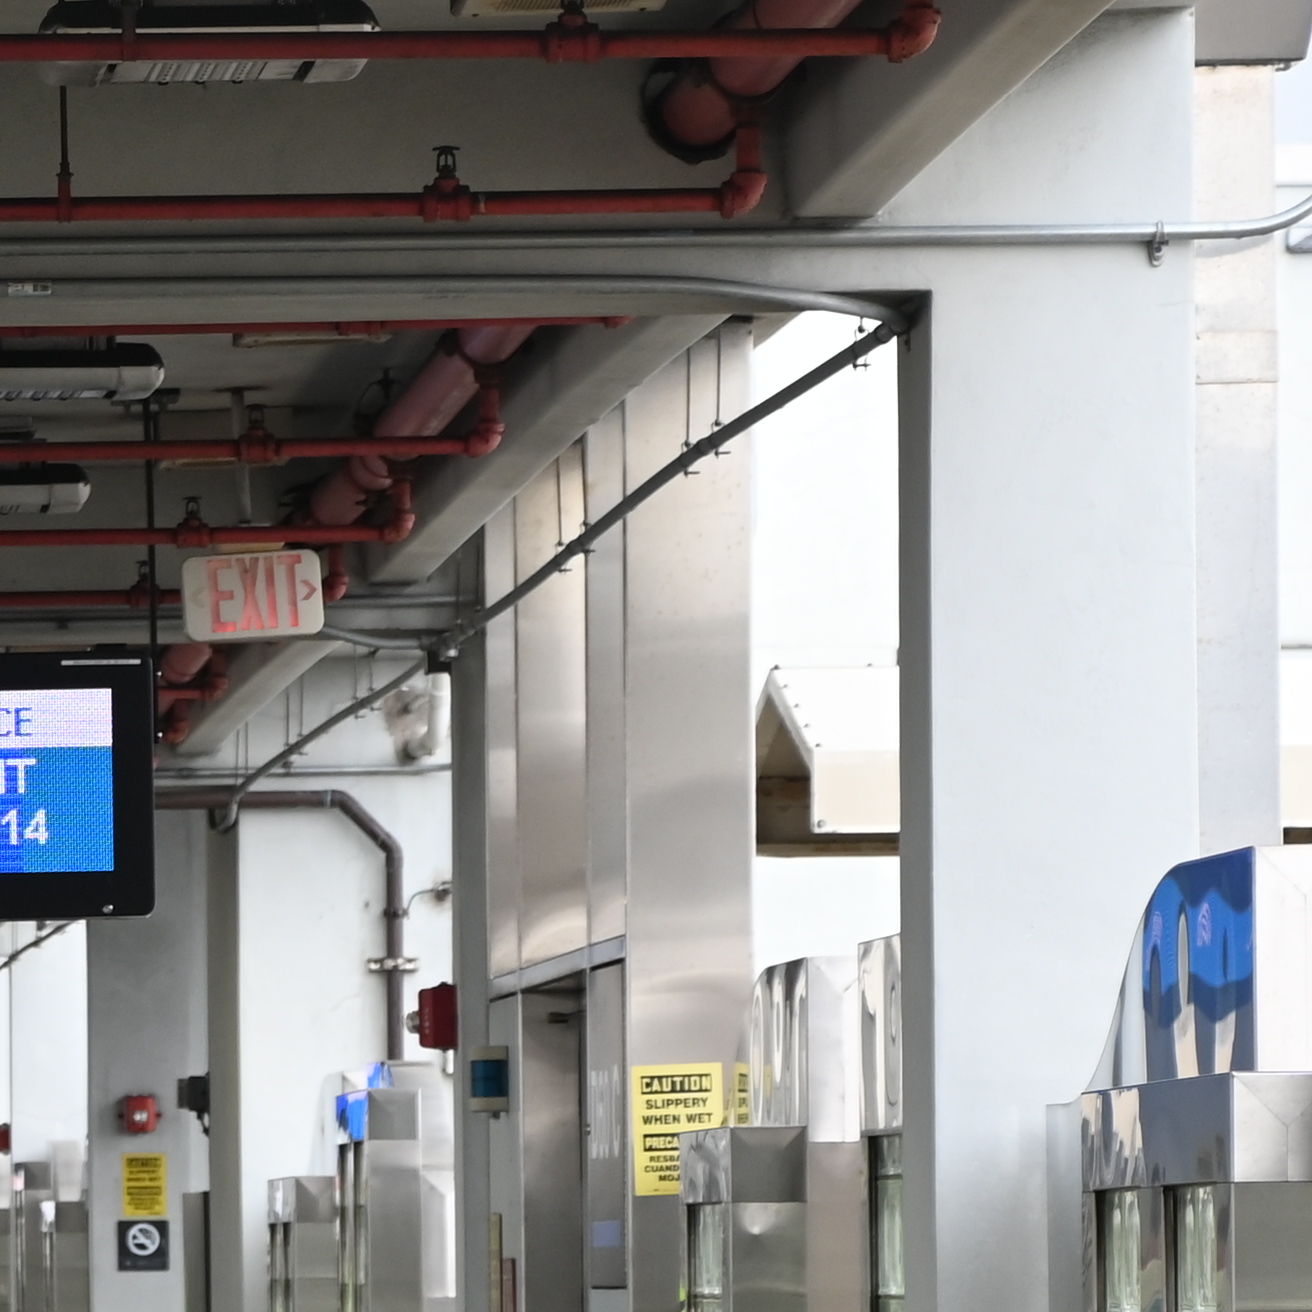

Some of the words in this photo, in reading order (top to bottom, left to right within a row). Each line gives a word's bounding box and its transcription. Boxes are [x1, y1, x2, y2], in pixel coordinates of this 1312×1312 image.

[206, 553, 302, 634] EXIT
[641, 1076, 712, 1092] CAUTION
[646, 1097, 709, 1110] SLIPPERY
[642, 1114, 681, 1125] WHEN
[686, 1112, 713, 1124] WET
[645, 1135, 680, 1149] PRECA
[644, 1165, 680, 1173] CUAND
